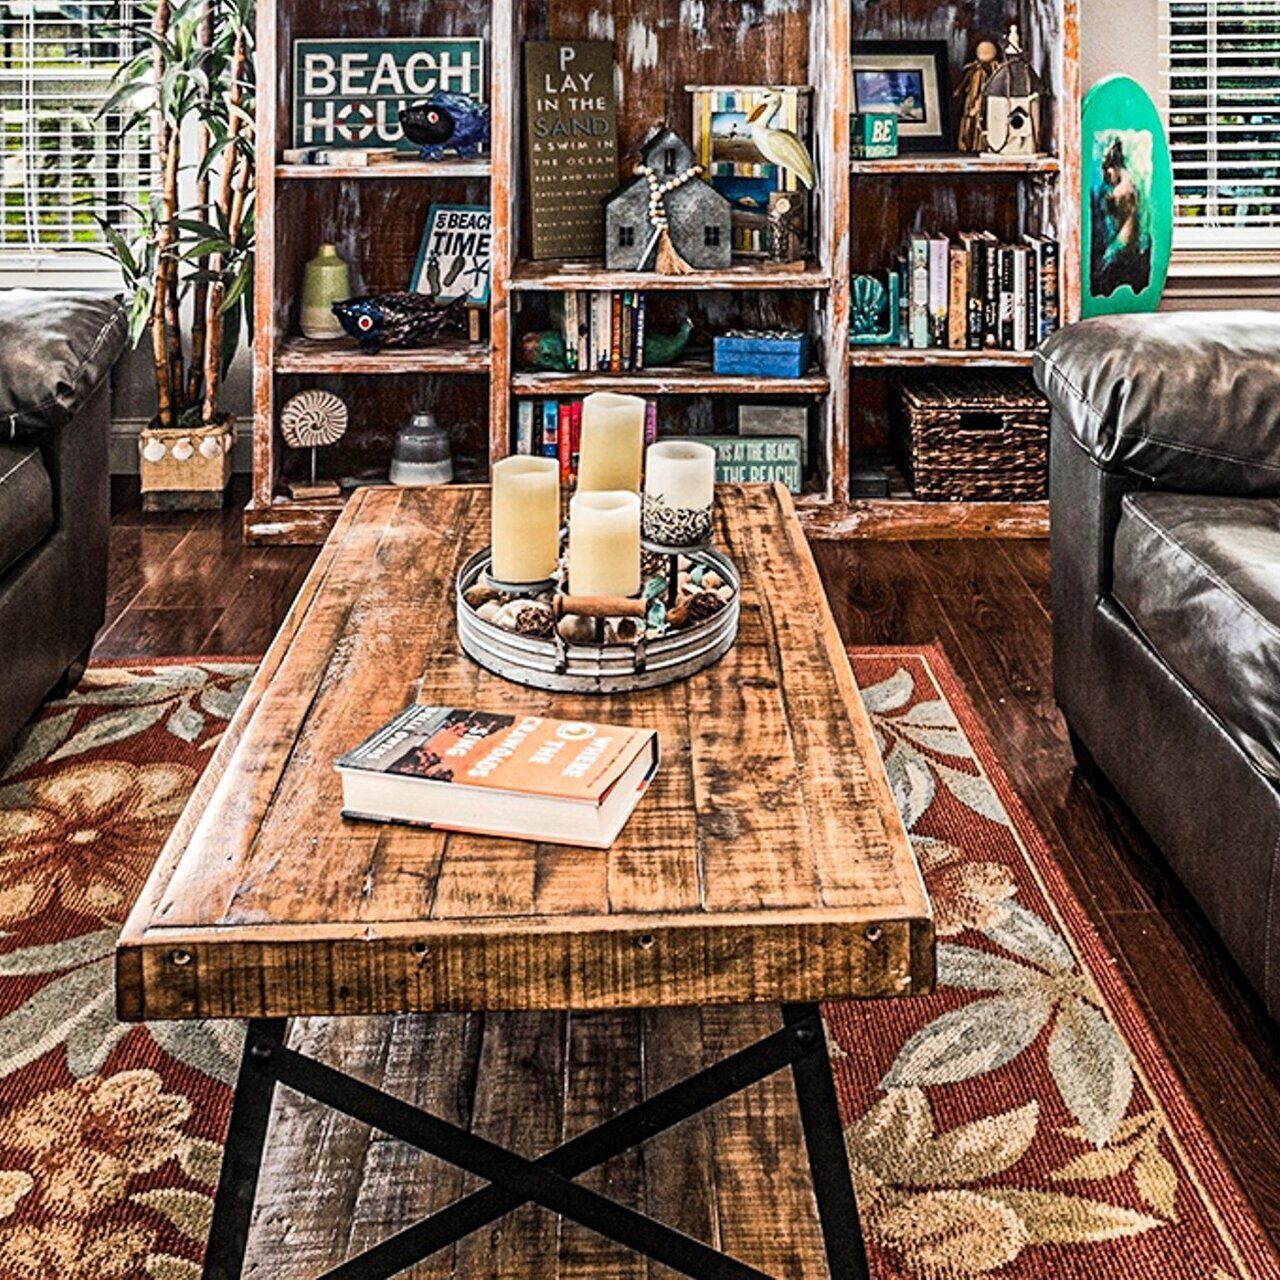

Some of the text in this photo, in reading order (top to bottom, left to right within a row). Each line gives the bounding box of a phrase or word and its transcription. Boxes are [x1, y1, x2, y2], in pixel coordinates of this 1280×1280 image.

[560, 46, 576, 72] P
[304, 51, 472, 96] BEACH
[545, 72, 594, 94] LAY
[536, 96, 606, 112] IN THE
[303, 100, 422, 143] HOU
[534, 116, 609, 138] SAND
[871, 119, 894, 143] BE
[547, 141, 588, 152] SWIM
[597, 140, 614, 148] IN
[533, 157, 615, 167] THE OCEAN
[433, 232, 491, 256] TIME
[722, 465, 747, 483] THE
